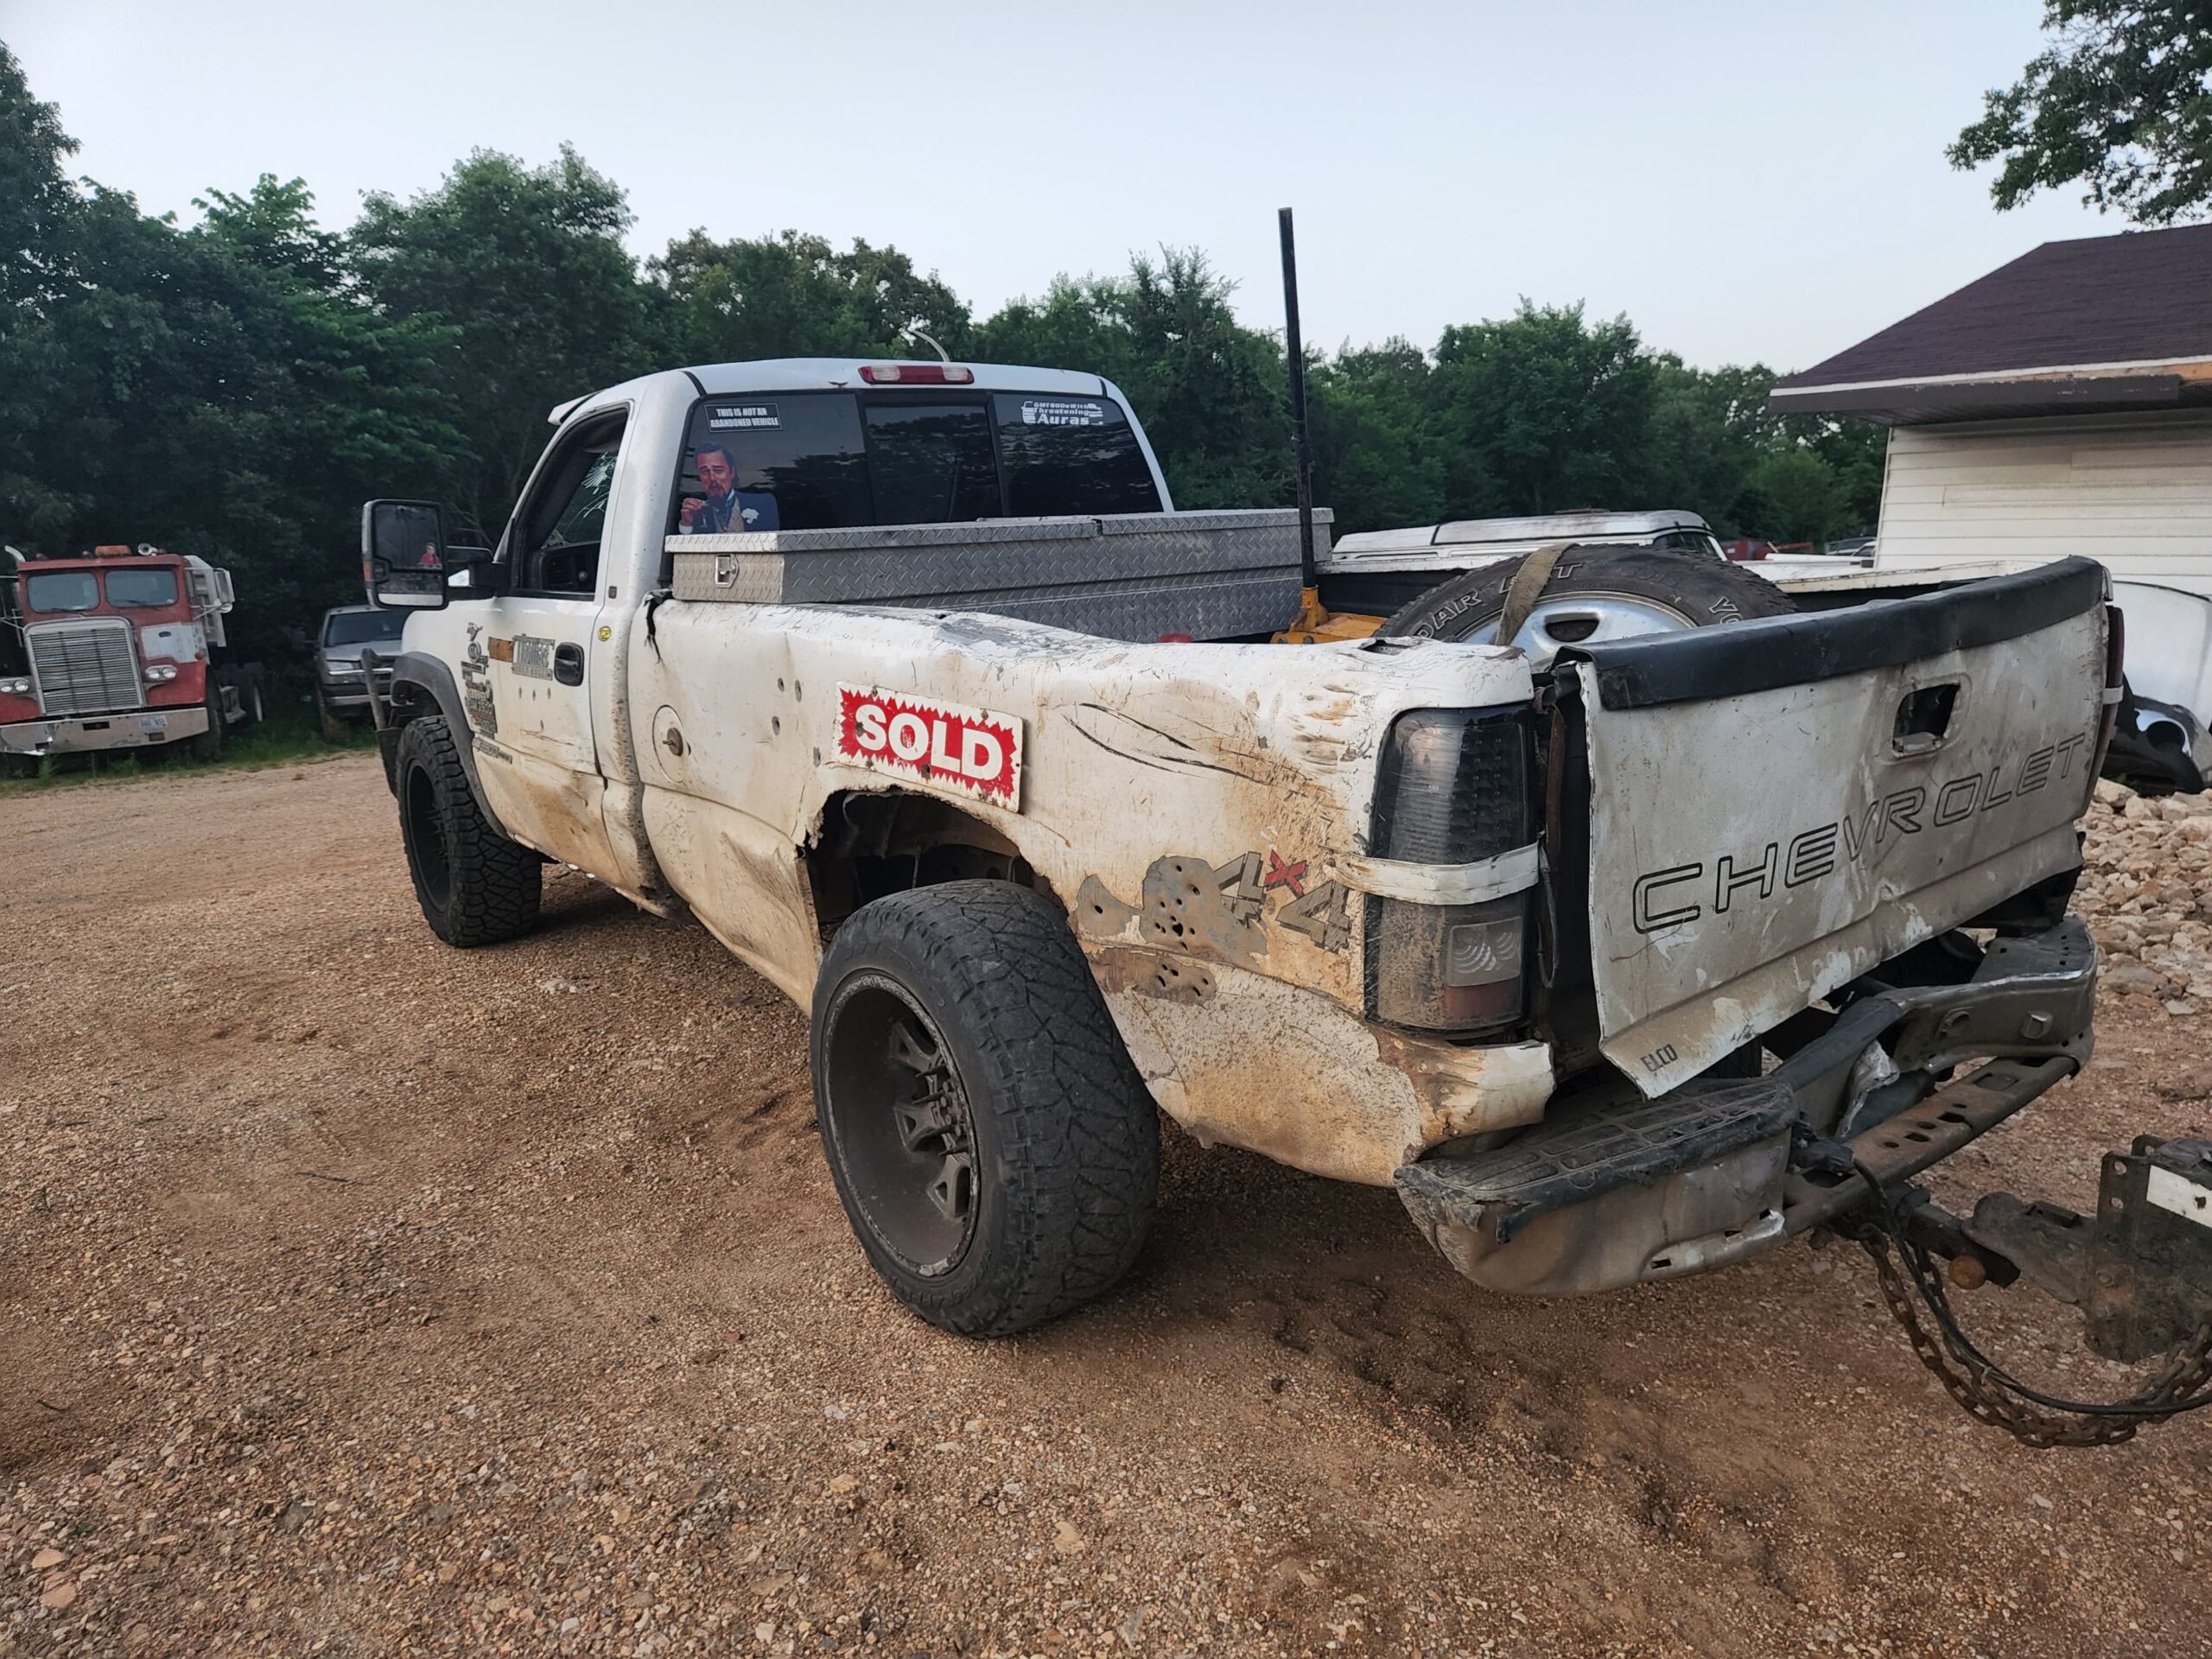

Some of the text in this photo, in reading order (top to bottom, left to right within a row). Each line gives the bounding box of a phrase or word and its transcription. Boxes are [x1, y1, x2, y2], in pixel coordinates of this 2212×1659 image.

[715, 408, 734, 417] THIS
[734, 408, 742, 416] IS
[757, 407, 767, 416] AN
[710, 417, 779, 428] ABANDONED VEHICLE
[1037, 414, 1090, 426] Auras
[855, 704, 1002, 780] SOLD
[1633, 734, 2085, 935] CHEVROLET
